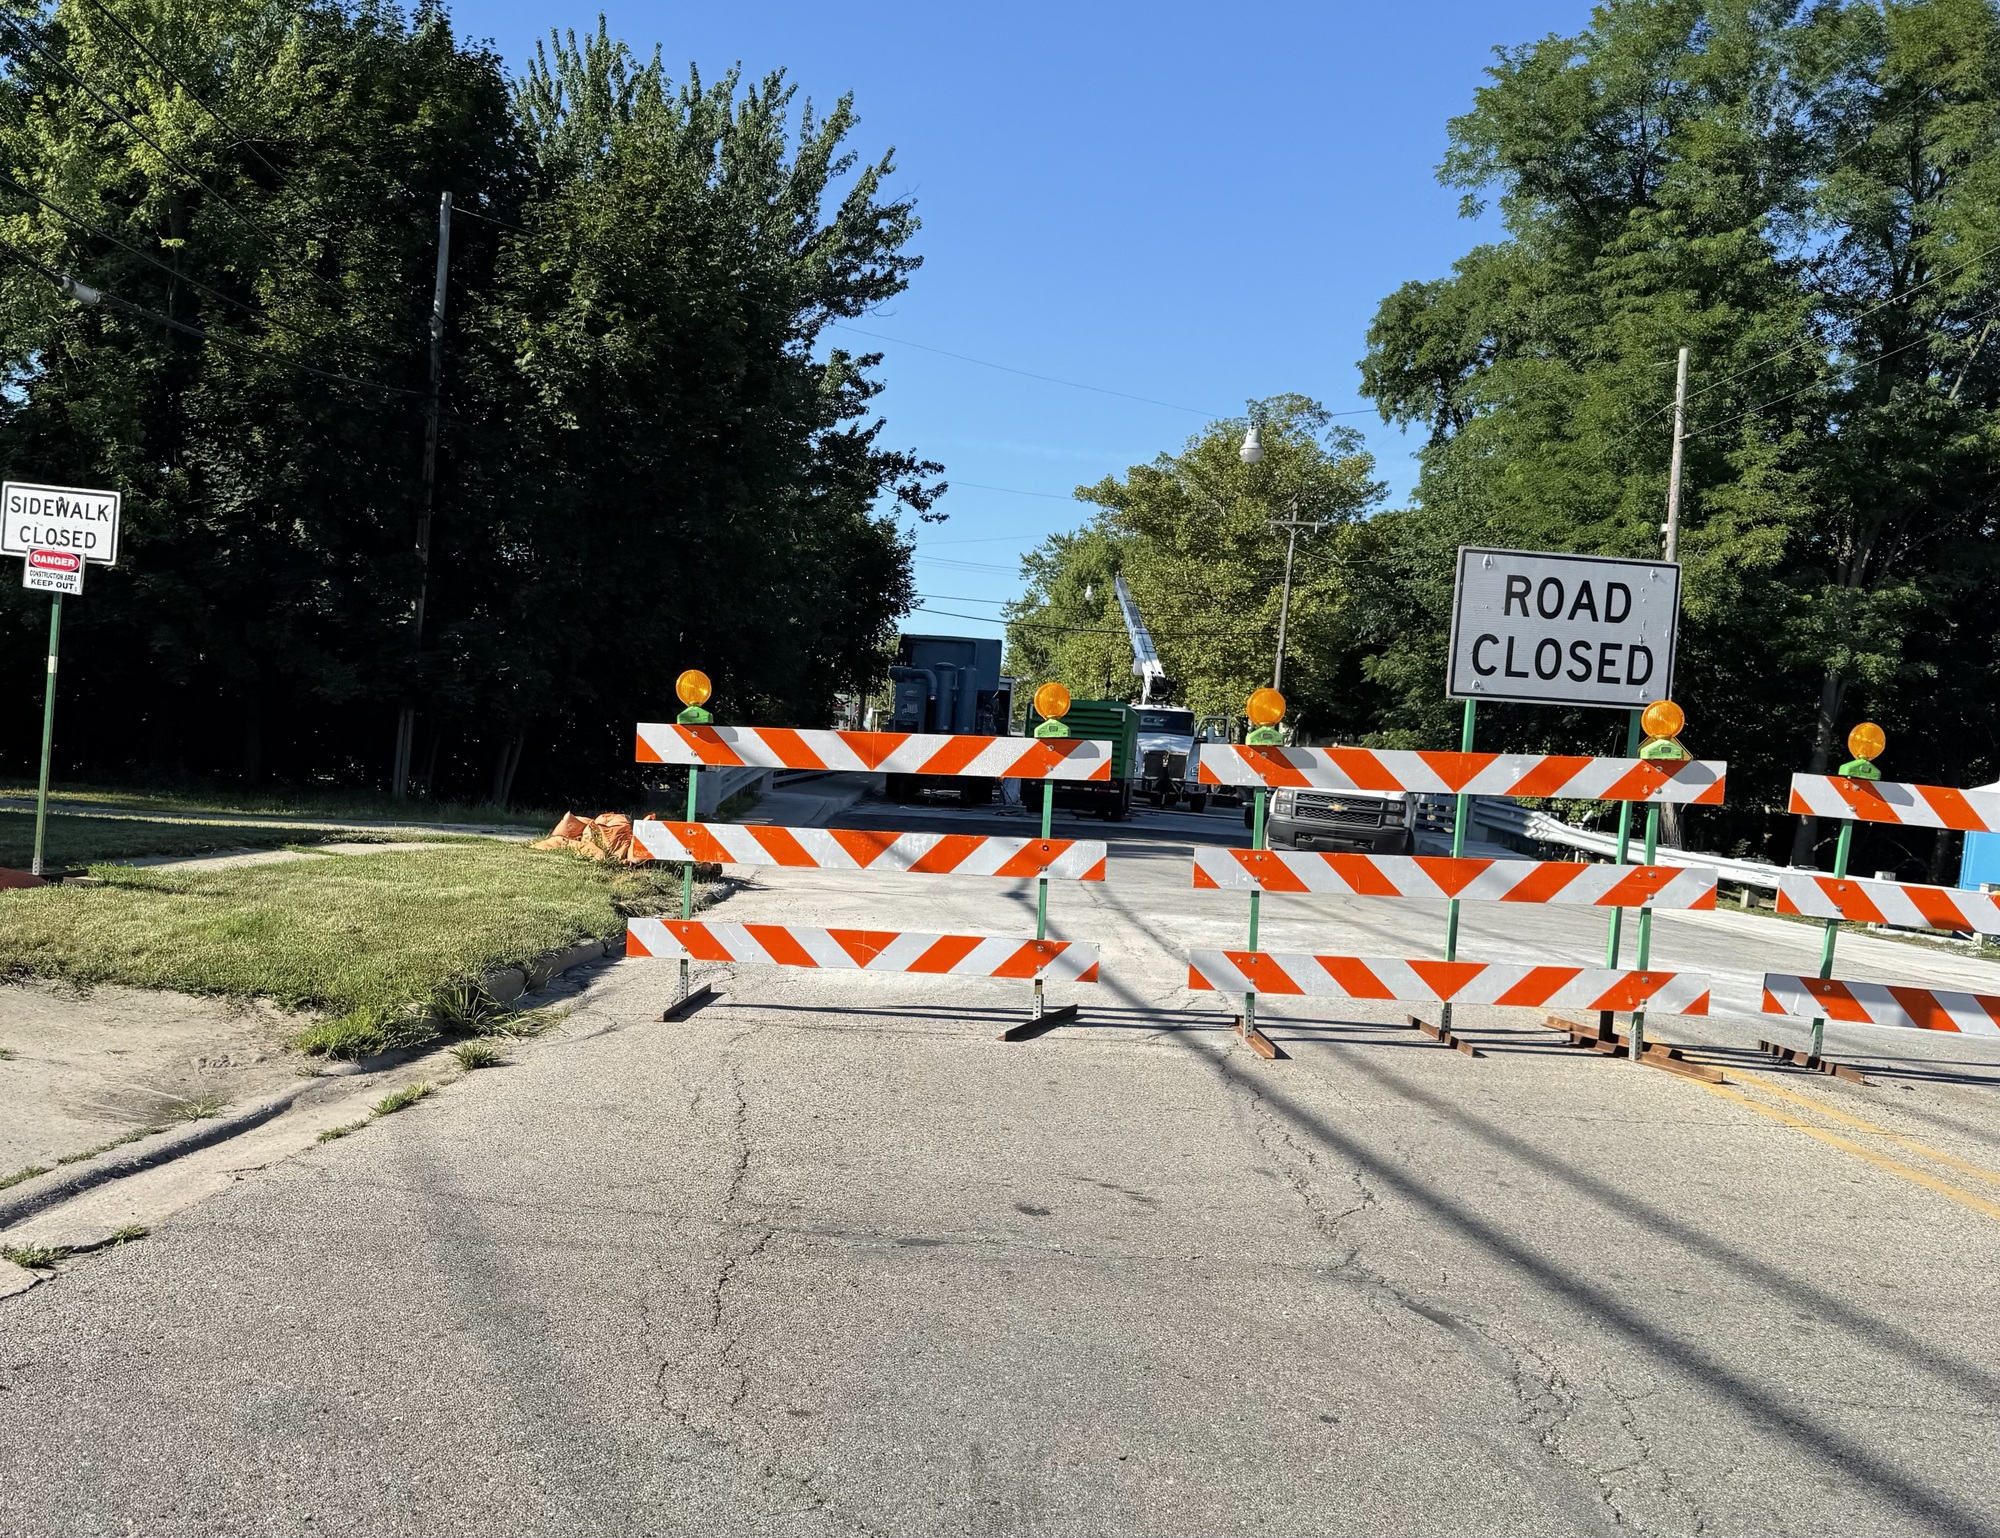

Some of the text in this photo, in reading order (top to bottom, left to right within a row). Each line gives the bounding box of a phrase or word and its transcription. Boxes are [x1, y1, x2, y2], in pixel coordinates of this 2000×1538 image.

[10, 496, 109, 522] SIDEWALK
[20, 525, 97, 549] CLOSED
[34, 554, 75, 567] DANGER
[29, 570, 77, 582] CONSTRUCTION AREA
[31, 578, 53, 587] KEEP
[56, 581, 74, 590] OUT
[1503, 574, 1632, 624] ROAD
[1472, 633, 1654, 686] CLOSED
